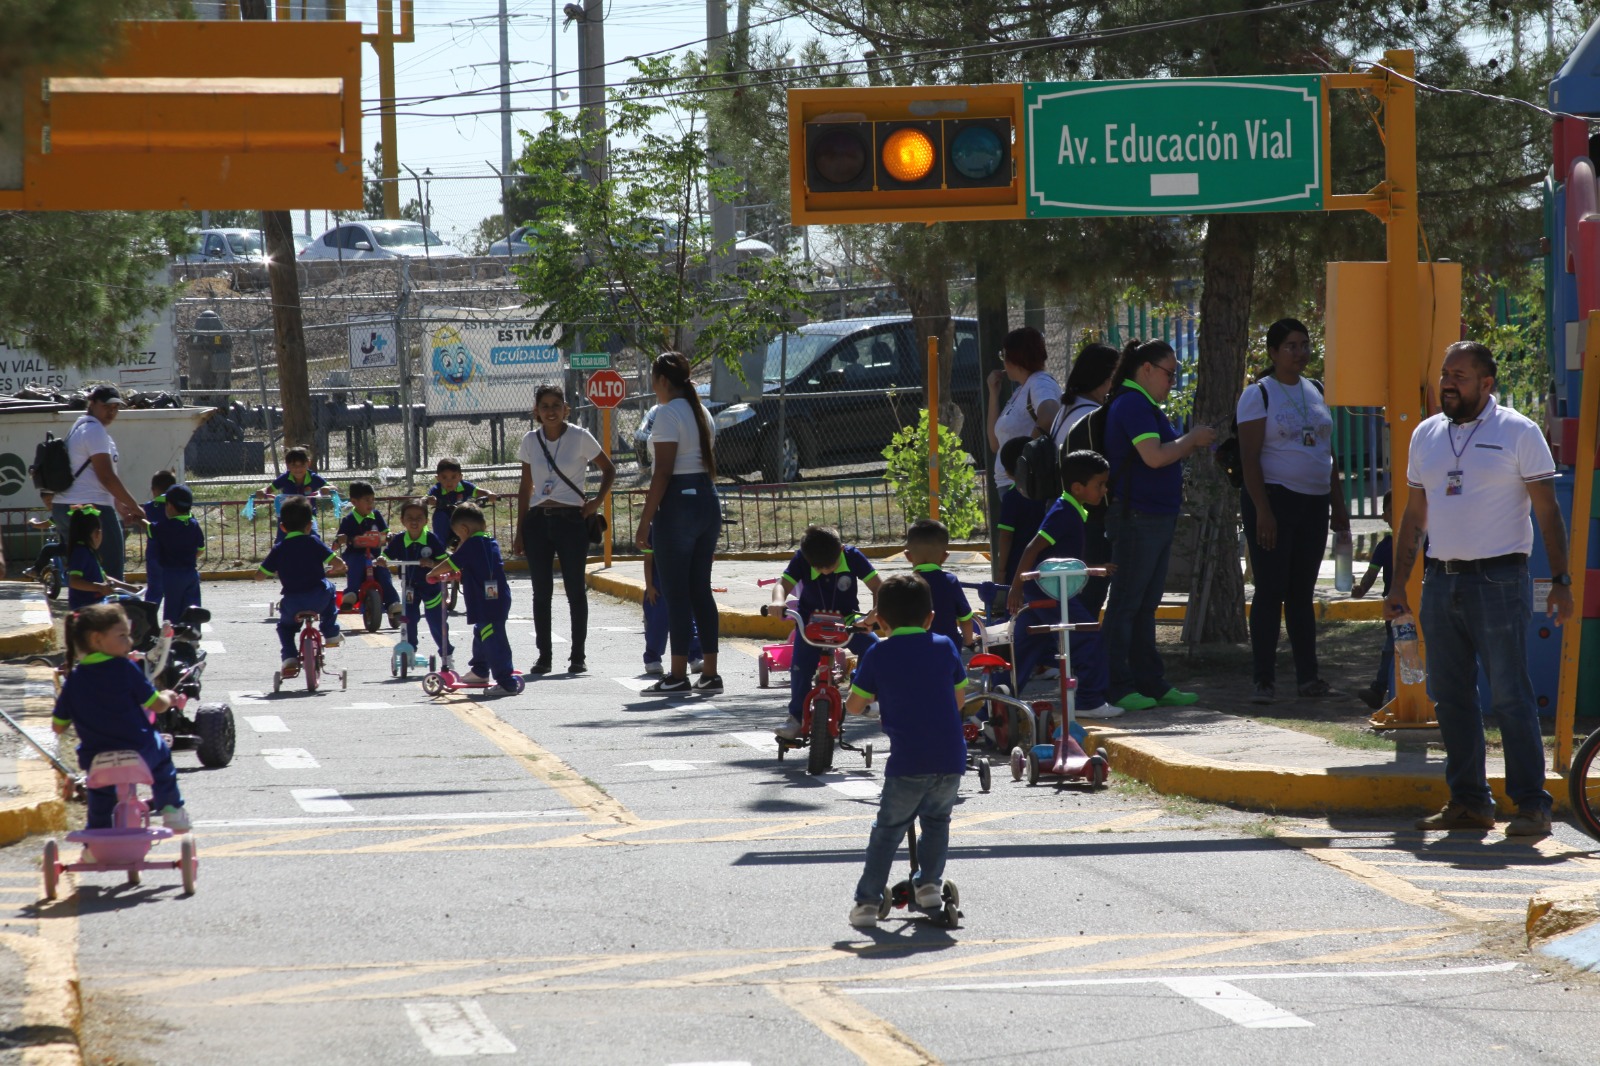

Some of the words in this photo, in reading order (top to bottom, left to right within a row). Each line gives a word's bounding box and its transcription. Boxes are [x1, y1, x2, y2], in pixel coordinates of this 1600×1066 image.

[1057, 124, 1097, 165] Av.
[1105, 120, 1238, 163] Educación
[1244, 118, 1292, 160] Vial
[497, 329, 513, 342] ES
[12, 359, 44, 373] VIAL
[117, 351, 157, 366] AREZ
[589, 381, 623, 397] ALTO
